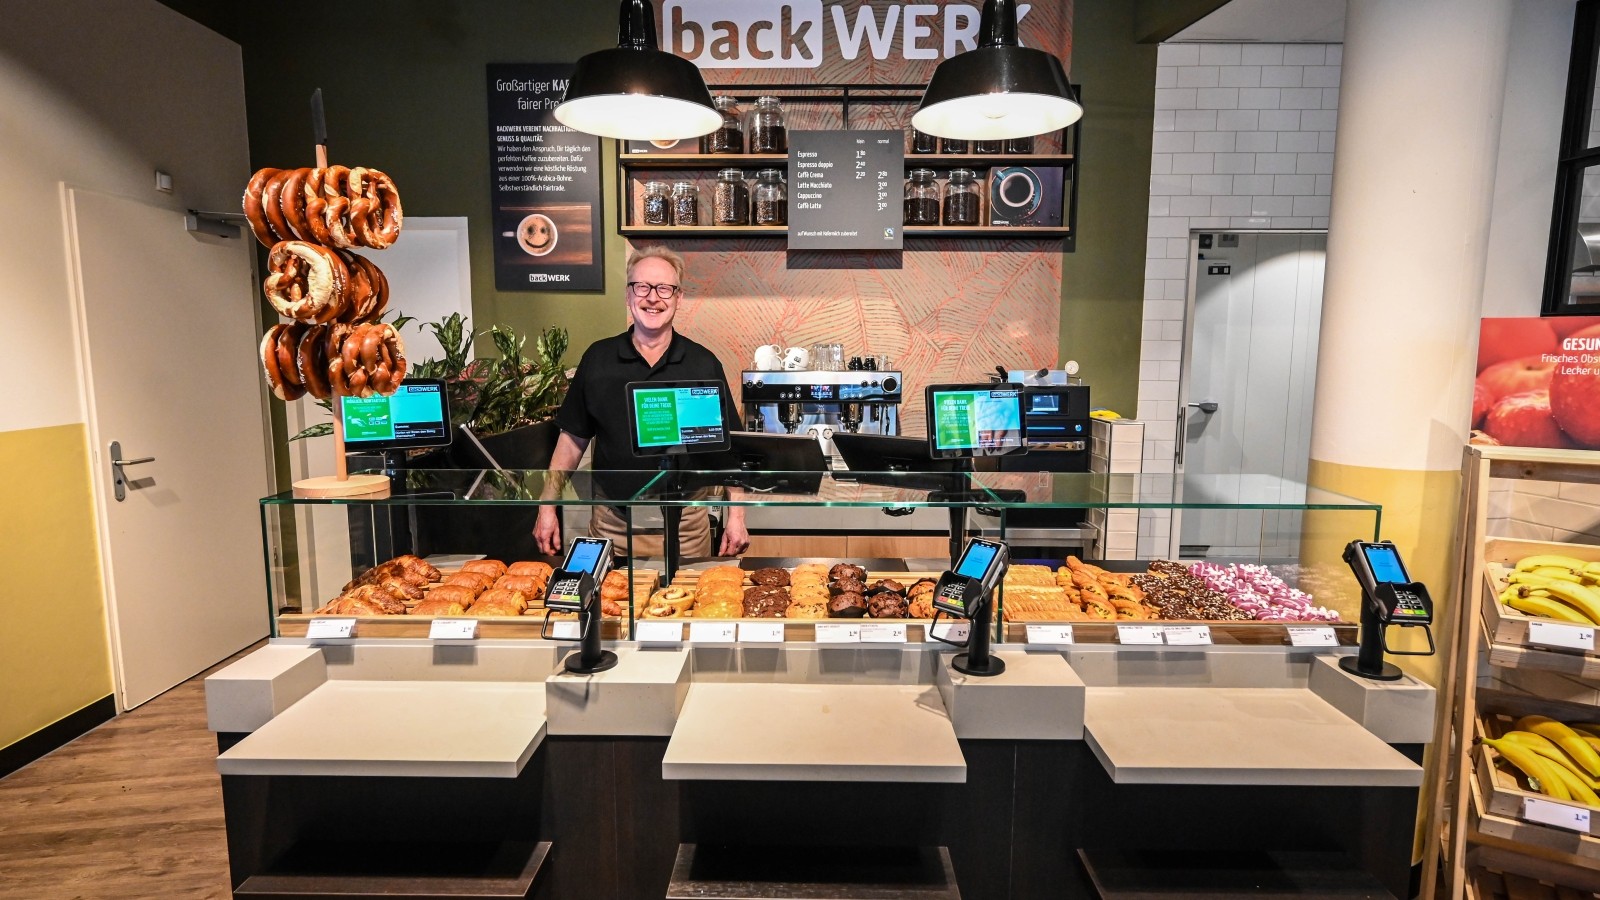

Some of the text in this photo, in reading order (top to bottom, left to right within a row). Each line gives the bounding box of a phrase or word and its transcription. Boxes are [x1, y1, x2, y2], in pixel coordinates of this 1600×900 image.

[496, 79, 550, 94] Großartiger
[517, 97, 562, 110] fairer Pre
[1541, 354, 1578, 363] Frisches
[1561, 366, 1591, 375] Lecker
